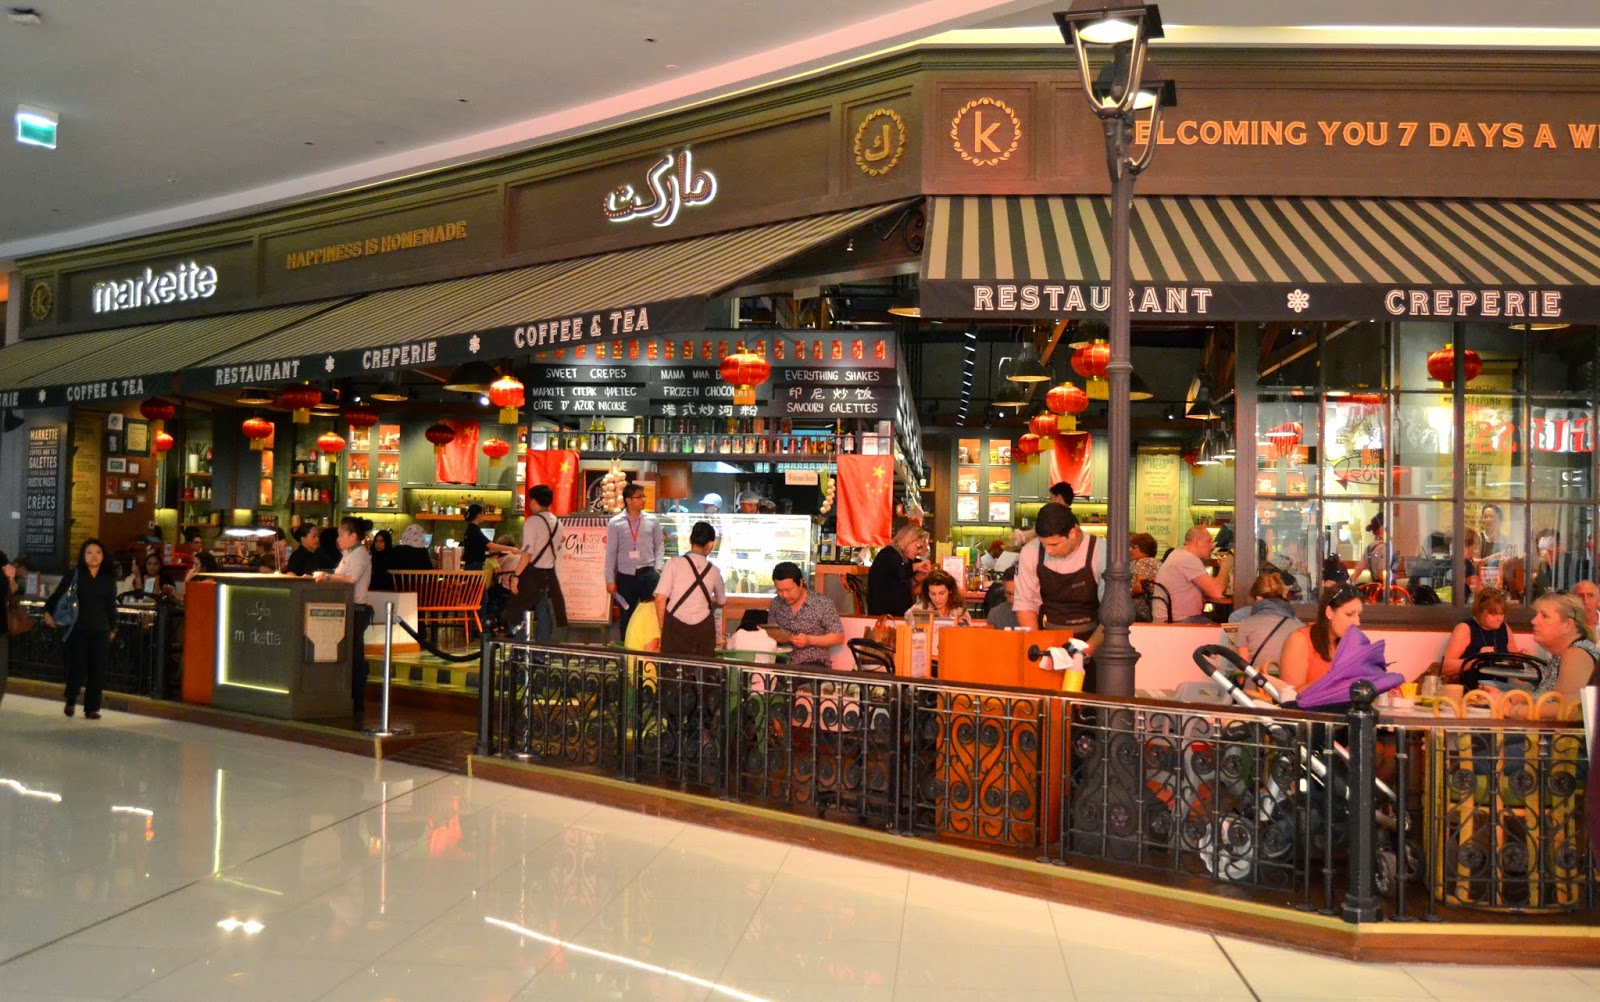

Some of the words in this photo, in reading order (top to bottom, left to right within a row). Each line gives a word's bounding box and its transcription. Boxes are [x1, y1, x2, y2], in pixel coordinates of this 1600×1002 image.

[1134, 120, 1308, 146] ELCOMING
[1317, 121, 1388, 147] YOU
[1397, 122, 1418, 147] 7
[1428, 122, 1525, 149] DAYS
[1533, 123, 1557, 149] A
[1568, 123, 1600, 149] W
[286, 240, 362, 270] HAPPINESS
[364, 236, 379, 256] IS
[381, 220, 468, 253] HOMEMADE
[92, 261, 218, 314] markette
[973, 284, 1213, 314] RESTAUANT
[1384, 288, 1562, 318] CREPERIE
[513, 317, 583, 349] COFFEE
[590, 314, 601, 338] &
[609, 307, 650, 335] TEA
[362, 340, 438, 370] CREPERIE
[215, 360, 301, 386] RESTAURANT
[545, 367, 578, 379] SWEET
[589, 367, 627, 379] CREPES
[784, 369, 840, 381] EVERYTHING
[844, 370, 880, 382] SHAKES
[66, 382, 108, 402] COFFEE
[110, 381, 118, 397] &
[121, 377, 144, 396] TEA
[663, 386, 700, 397] FROZEN
[572, 400, 595, 412] AZUR
[786, 402, 824, 413] SAVOURY
[829, 402, 878, 414] GALETTES
[30, 428, 58, 441] MARKETTE
[29, 456, 58, 469] GALETTES
[27, 494, 56, 509] CRÊPES
